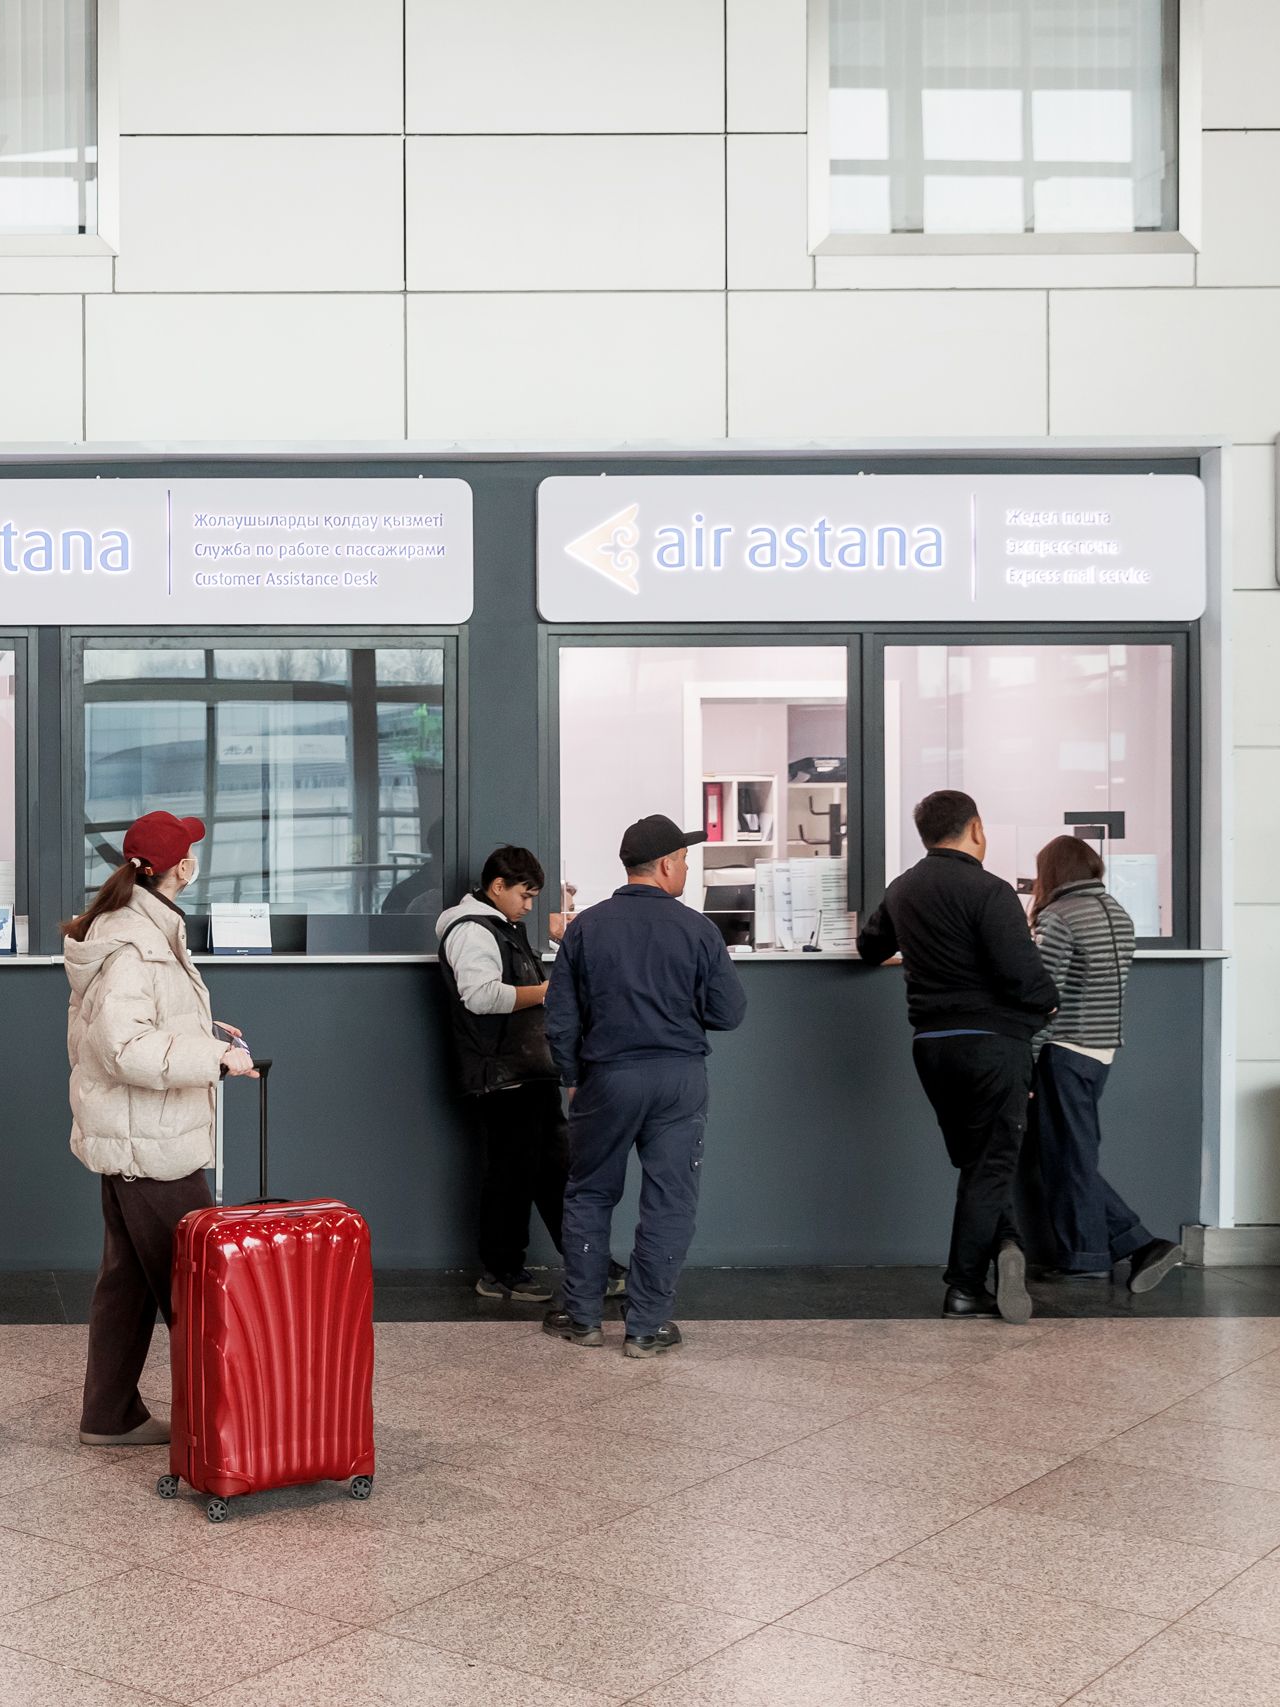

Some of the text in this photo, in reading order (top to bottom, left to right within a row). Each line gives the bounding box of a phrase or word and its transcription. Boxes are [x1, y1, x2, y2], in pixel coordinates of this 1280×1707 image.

[193, 513, 444, 529] Жолаушыларды қолдау қызметі
[656, 515, 943, 569] air astana
[194, 543, 446, 559] Служба по работе с пассажирами
[194, 571, 379, 586] Customer Assistance Desk
[1006, 567, 1061, 587] Express
[1099, 567, 1151, 584] service
